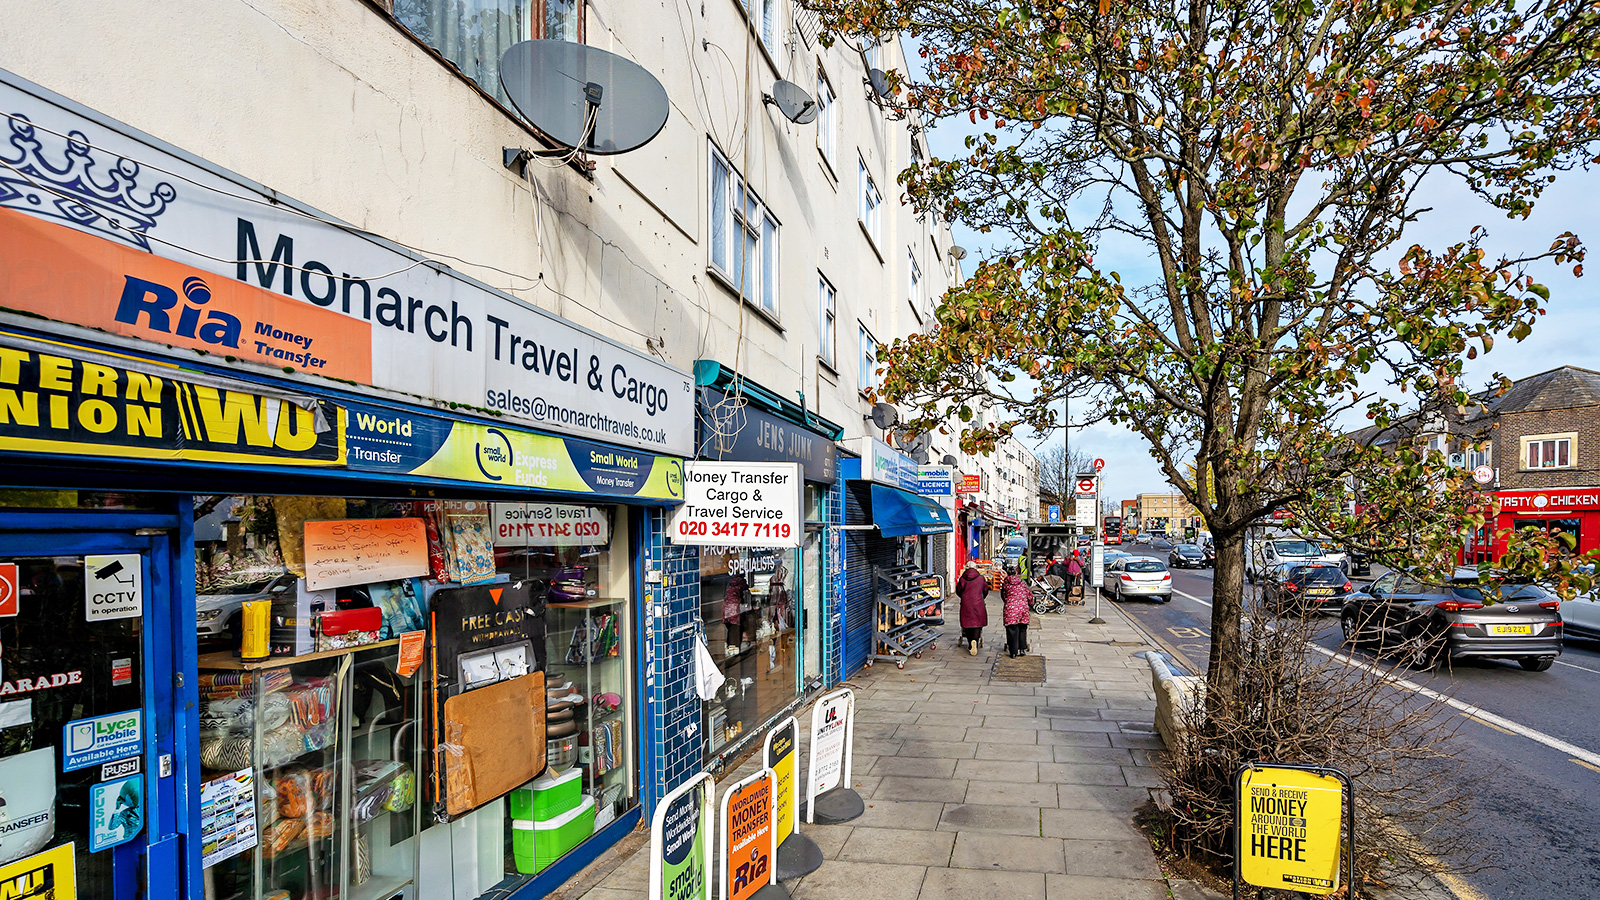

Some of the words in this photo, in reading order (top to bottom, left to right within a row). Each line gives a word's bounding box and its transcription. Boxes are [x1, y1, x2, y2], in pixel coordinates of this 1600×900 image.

[115, 275, 243, 349] Ria
[237, 217, 473, 352] Monarch
[487, 314, 578, 384] Travel
[587, 355, 604, 393] &
[611, 364, 668, 416] Cargo
[254, 321, 314, 349] Money
[254, 341, 327, 368] Transfer
[0, 347, 163, 404] TERN
[683, 381, 690, 393] 75
[356, 412, 412, 438] World
[486, 389, 667, 444] sales@monarchtravels.co.uk
[756, 420, 784, 453] JENS
[788, 432, 812, 461] JUNK
[353, 446, 402, 464] Transfer
[514, 450, 558, 470] Express
[590, 450, 614, 465] Small
[616, 454, 638, 469] World
[515, 469, 548, 486] Funds
[596, 476, 614, 487] Money
[615, 478, 634, 488] Transfer
[731, 472, 789, 484] Transfer
[706, 488, 748, 503] Cargo
[752, 489, 763, 501] &
[1500, 496, 1532, 507] TASTY
[1550, 495, 1599, 506] CHICKEN
[686, 505, 728, 518] Travel
[732, 506, 783, 519] Service
[679, 521, 707, 536] 020
[711, 522, 749, 536] 3417
[753, 523, 791, 538] 7119
[728, 556, 776, 576] SPECIALISTS
[92, 592, 136, 605] CCTV
[101, 605, 138, 615] operation
[462, 614, 492, 632] FREE
[0, 670, 82, 696] ARADE
[96, 718, 136, 734] Lyca
[97, 729, 136, 743] mobile
[69, 750, 114, 765] Available
[116, 744, 138, 754] Here
[104, 761, 136, 776] PUSH
[732, 785, 769, 813] WORLDWIDE
[1251, 787, 1270, 797] SEND
[1272, 788, 1277, 797] &
[1279, 789, 1308, 800] RECEIVE
[96, 788, 105, 829] PUSH
[666, 808, 680, 827] Send
[679, 800, 694, 817] Money
[732, 796, 768, 830] MONEY
[1251, 796, 1307, 817] MONEY
[666, 815, 692, 841] Worldwide
[732, 813, 768, 842] TRANSFER
[1251, 814, 1288, 826] AROUND
[1251, 823, 1268, 835] THE
[1271, 825, 1306, 838] WORLD
[666, 835, 682, 856] Small
[682, 823, 696, 843] World
[732, 830, 757, 854] Available
[757, 825, 769, 838] Here
[1251, 834, 1306, 862] HERE
[670, 855, 695, 898] small
[733, 846, 768, 896] Ria
